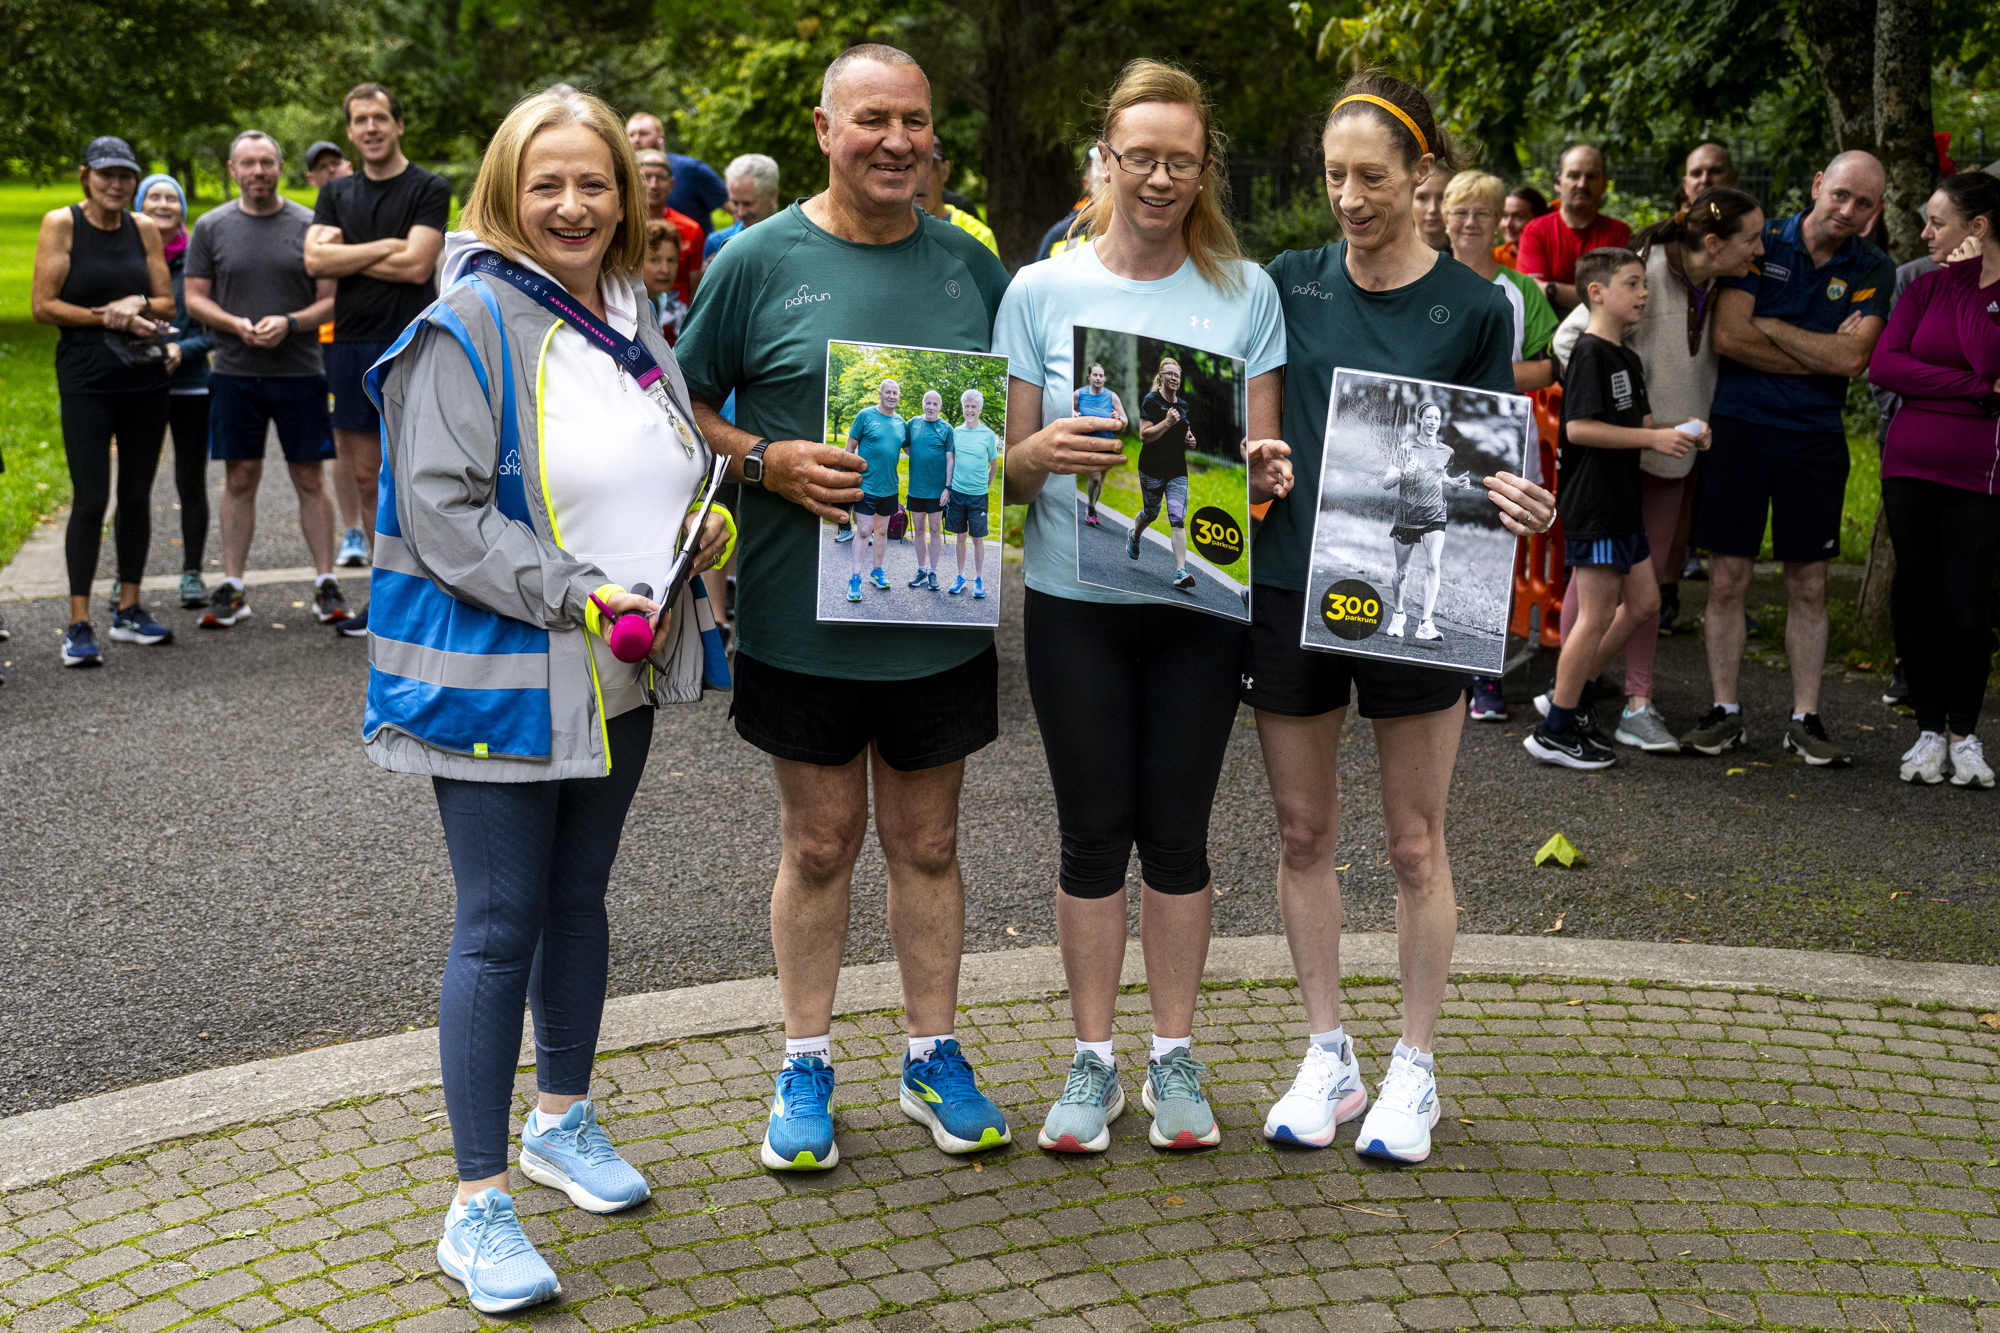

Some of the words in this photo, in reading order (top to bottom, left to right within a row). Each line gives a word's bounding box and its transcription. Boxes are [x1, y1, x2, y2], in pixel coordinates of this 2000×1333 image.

[785, 284, 831, 310] parkrun
[1291, 281, 1334, 300] parkrun
[506, 269, 548, 297] QUEST
[551, 297, 589, 327] ADVENTURE
[591, 327, 614, 347] SERIES
[1195, 518, 1240, 545] 300
[1211, 540, 1240, 552] parkruns
[1326, 593, 1379, 620] 300
[1345, 615, 1378, 625] parkruns
